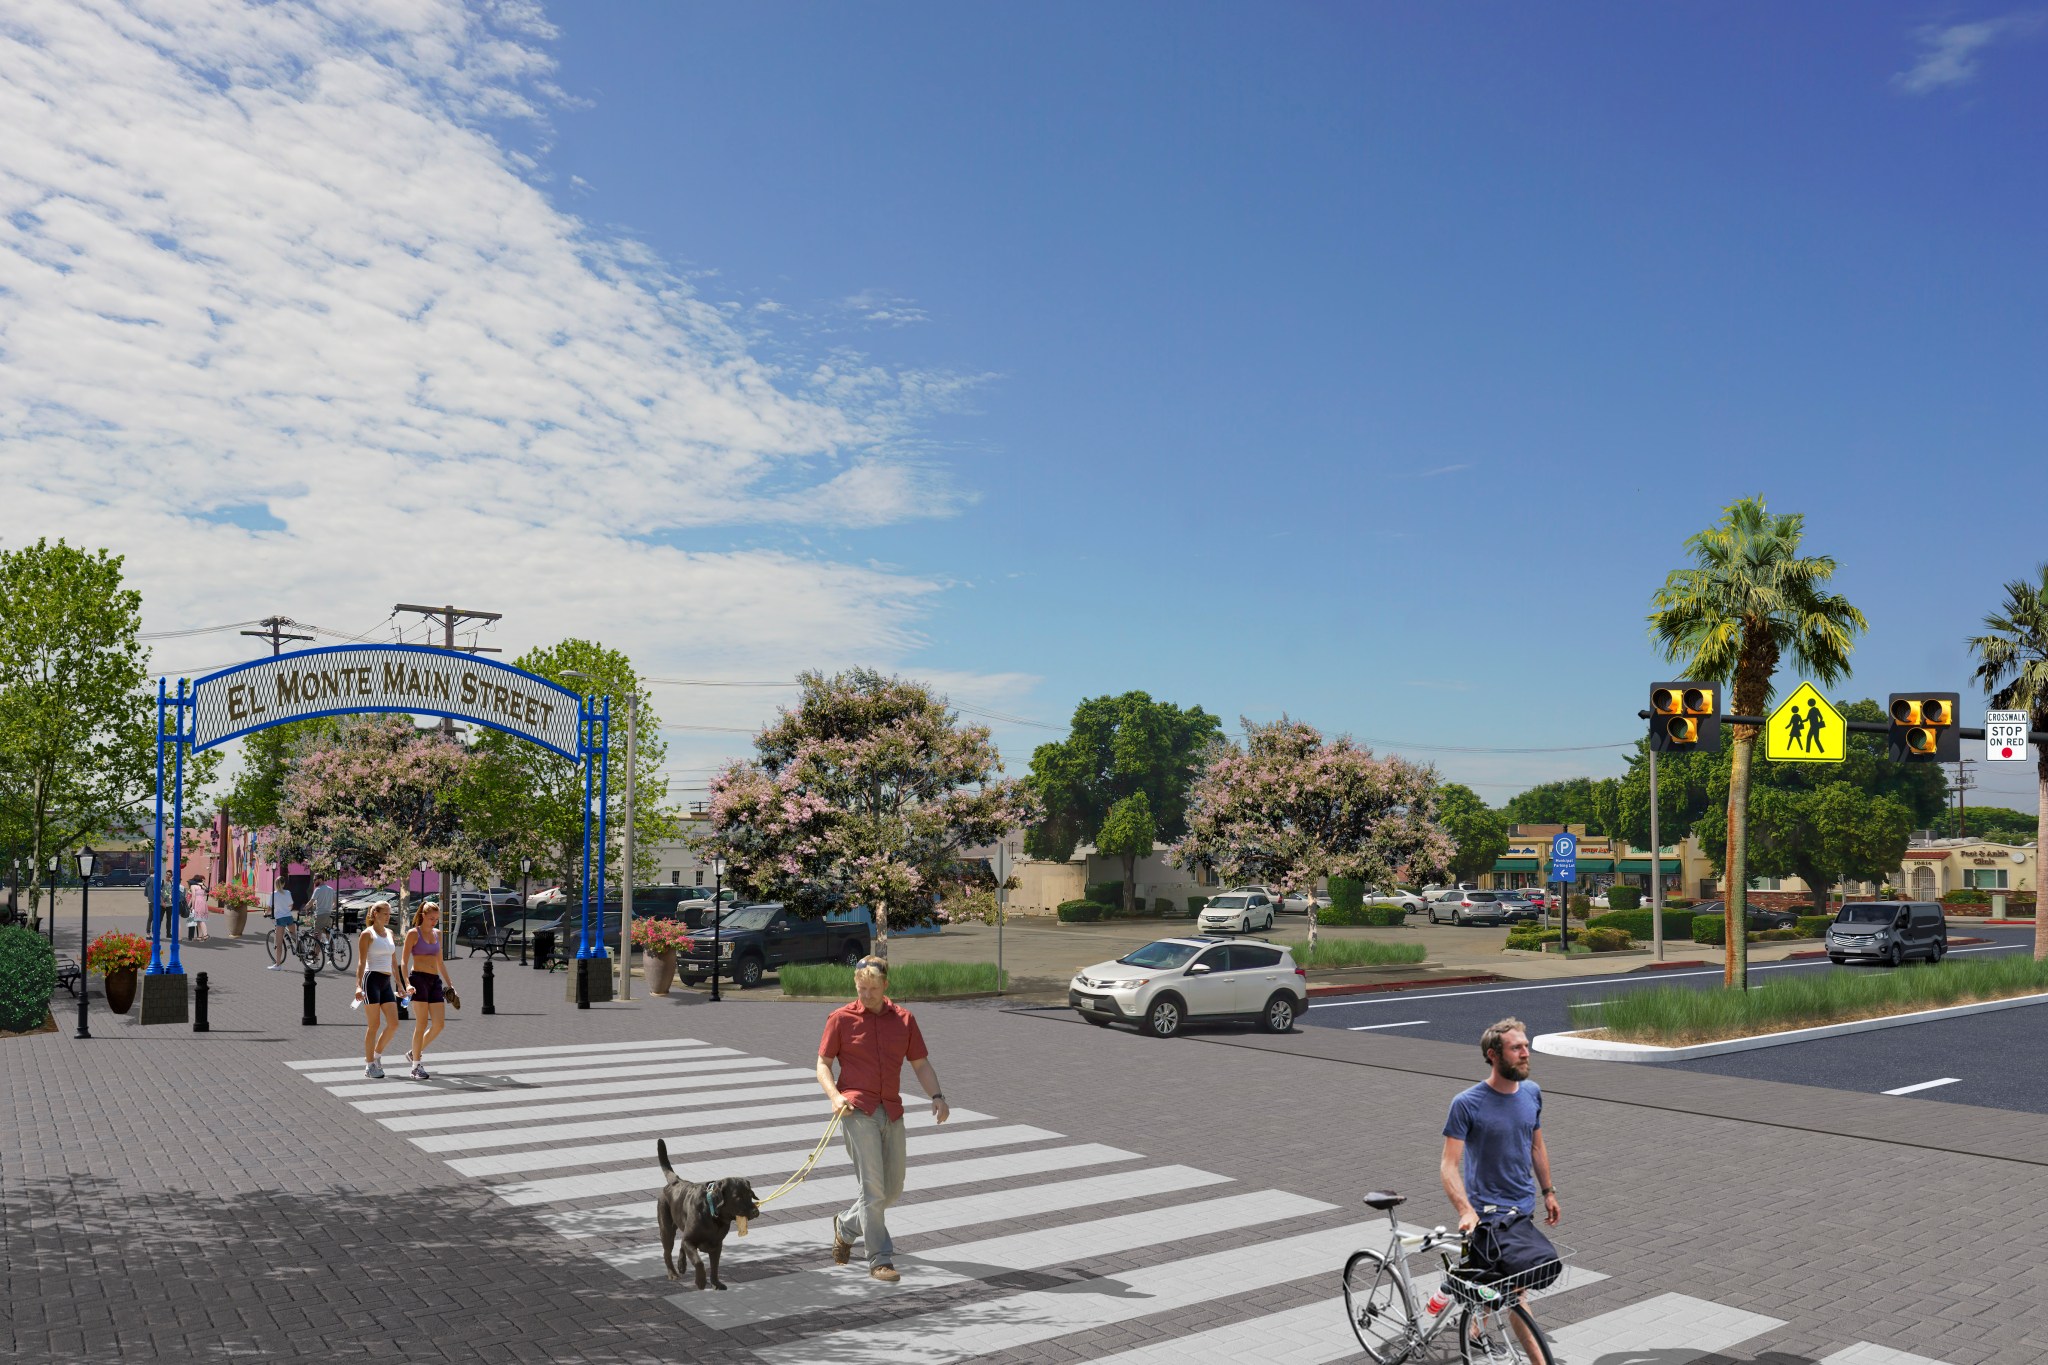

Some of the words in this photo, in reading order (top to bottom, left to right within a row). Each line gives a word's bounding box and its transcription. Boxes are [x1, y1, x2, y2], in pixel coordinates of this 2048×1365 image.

[227, 684, 266, 722] EL
[276, 667, 373, 707] MONTE
[383, 661, 450, 700] MAIN
[460, 672, 554, 731] STREET
[1988, 713, 2026, 722] CROSSWALK
[1991, 726, 2023, 737] STOP
[1989, 737, 2003, 747] ON
[2006, 737, 2025, 747] RED
[1560, 841, 1569, 854] P
[1960, 850, 1978, 858] Foot
[1986, 850, 2009, 858] Ankle
[1973, 858, 1996, 866] Clinic
